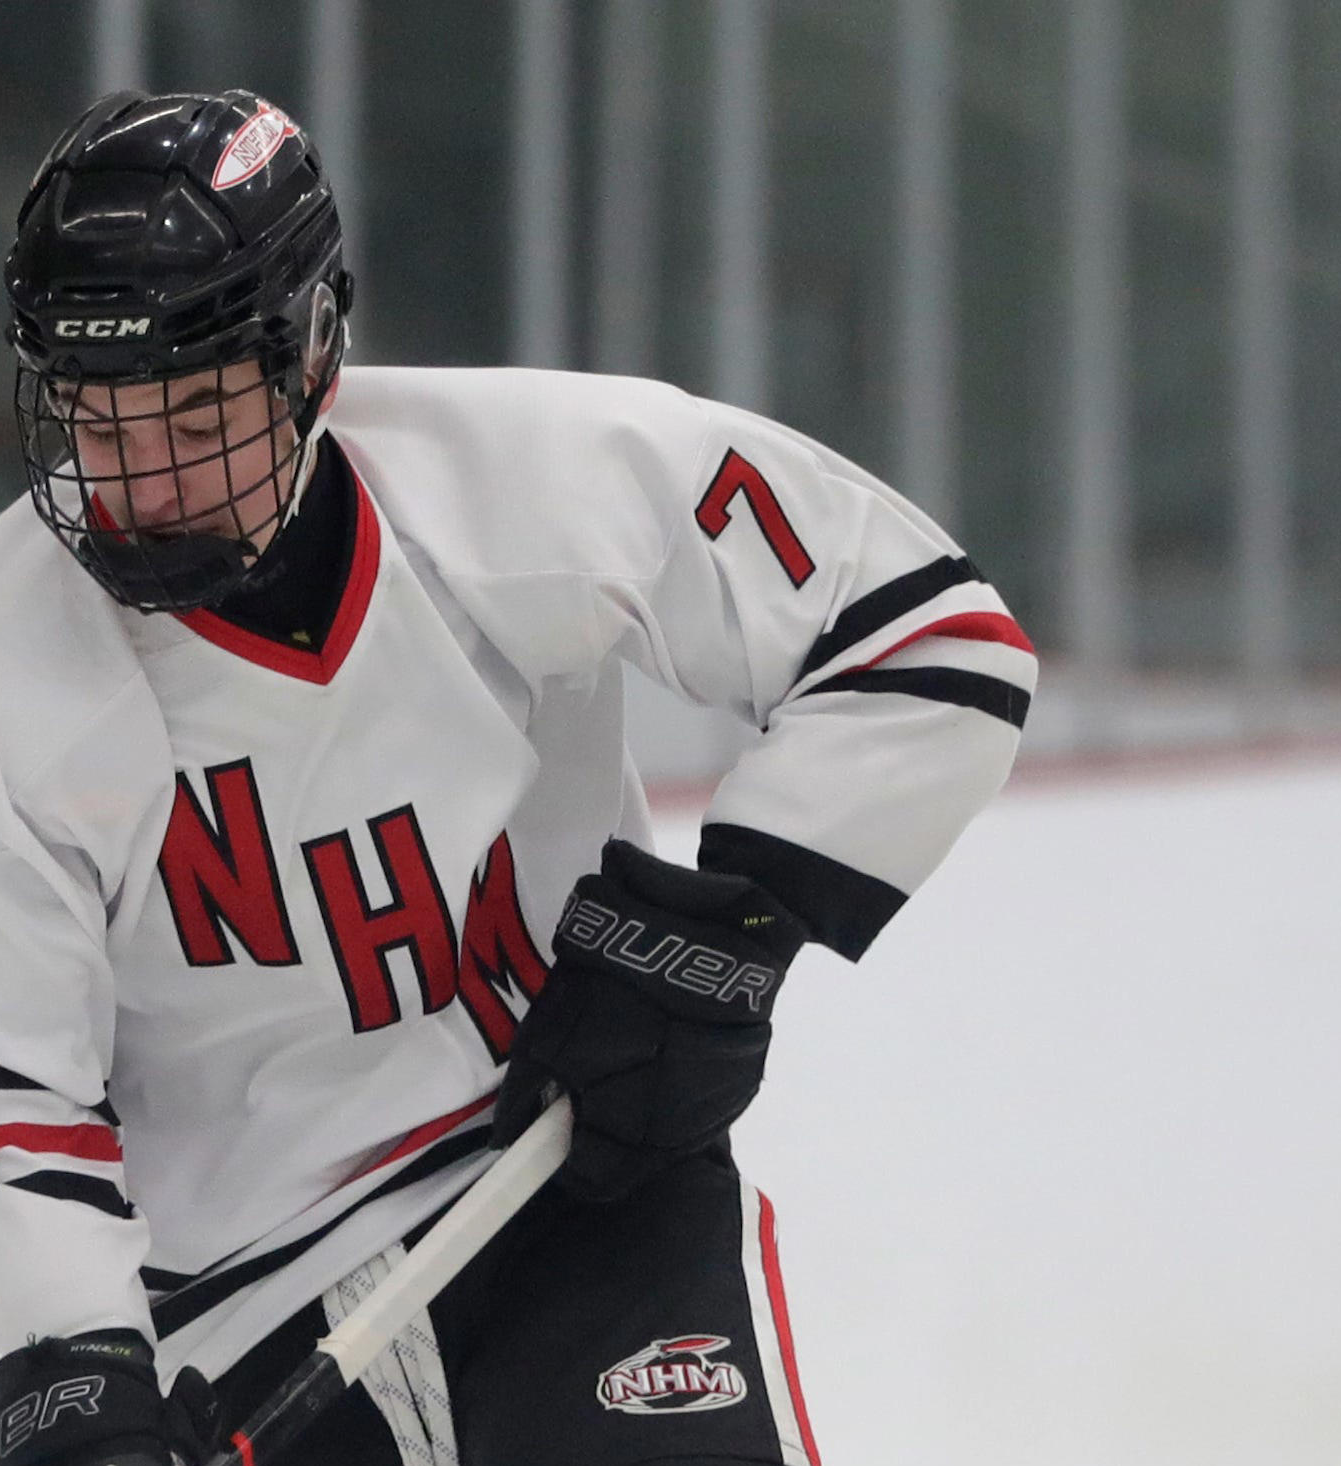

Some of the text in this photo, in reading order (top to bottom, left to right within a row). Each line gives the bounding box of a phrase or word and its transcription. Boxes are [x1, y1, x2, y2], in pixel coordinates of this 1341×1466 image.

[54, 317, 152, 338] CCM
[695, 446, 816, 591] 7
[158, 756, 551, 1068] NHM
[558, 894, 777, 1013] AUER
[607, 1362, 736, 1404] NHM
